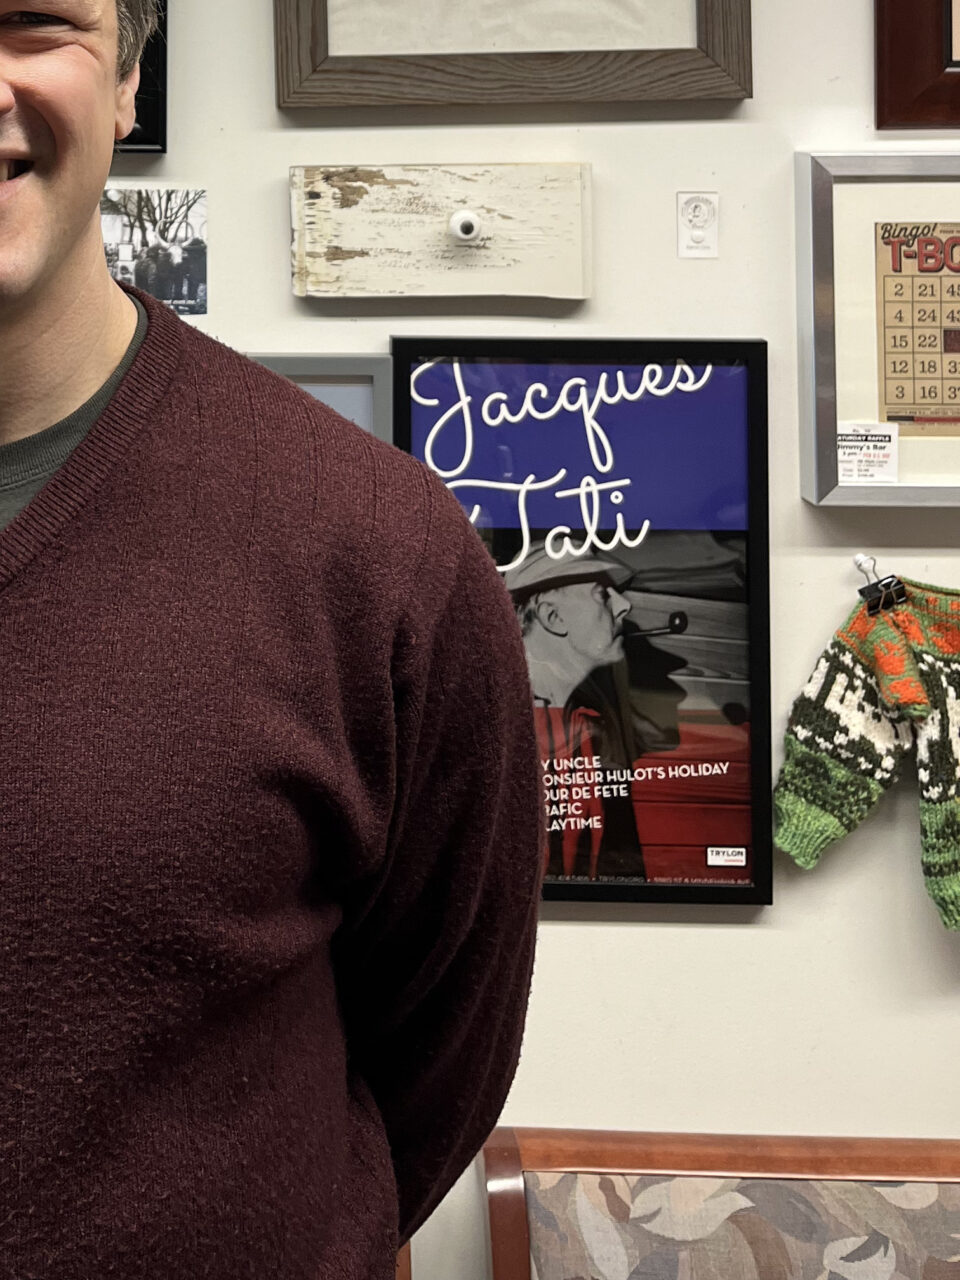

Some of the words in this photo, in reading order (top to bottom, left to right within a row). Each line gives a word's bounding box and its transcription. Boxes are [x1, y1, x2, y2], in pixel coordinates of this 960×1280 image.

[880, 222, 939, 248] Bingo!
[894, 283, 904, 297] 2
[918, 283, 936, 297] 21
[894, 308, 904, 323] 4
[917, 308, 937, 322] 24
[891, 334, 909, 348] 15
[917, 334, 938, 348] 22
[890, 359, 909, 374] 12
[919, 359, 937, 374] 18
[948, 359, 960, 374] 3
[895, 385, 905, 400] 3
[920, 385, 938, 400] 16
[947, 385, 960, 400] 3
[410, 357, 713, 478] Jacques
[445, 468, 651, 572] Tati
[540, 758, 550, 772] Y
[553, 755, 602, 771] UNCLE
[542, 770, 604, 787] ONSIEUR
[606, 766, 666, 783] HULOT'S
[668, 761, 730, 779] HOLIDAY
[544, 787, 570, 802] UR
[571, 786, 592, 800] DE
[594, 784, 629, 799] FETE
[545, 802, 583, 817] RAFIC
[545, 815, 603, 832] AYTIME
[710, 849, 745, 857] TRYLON
